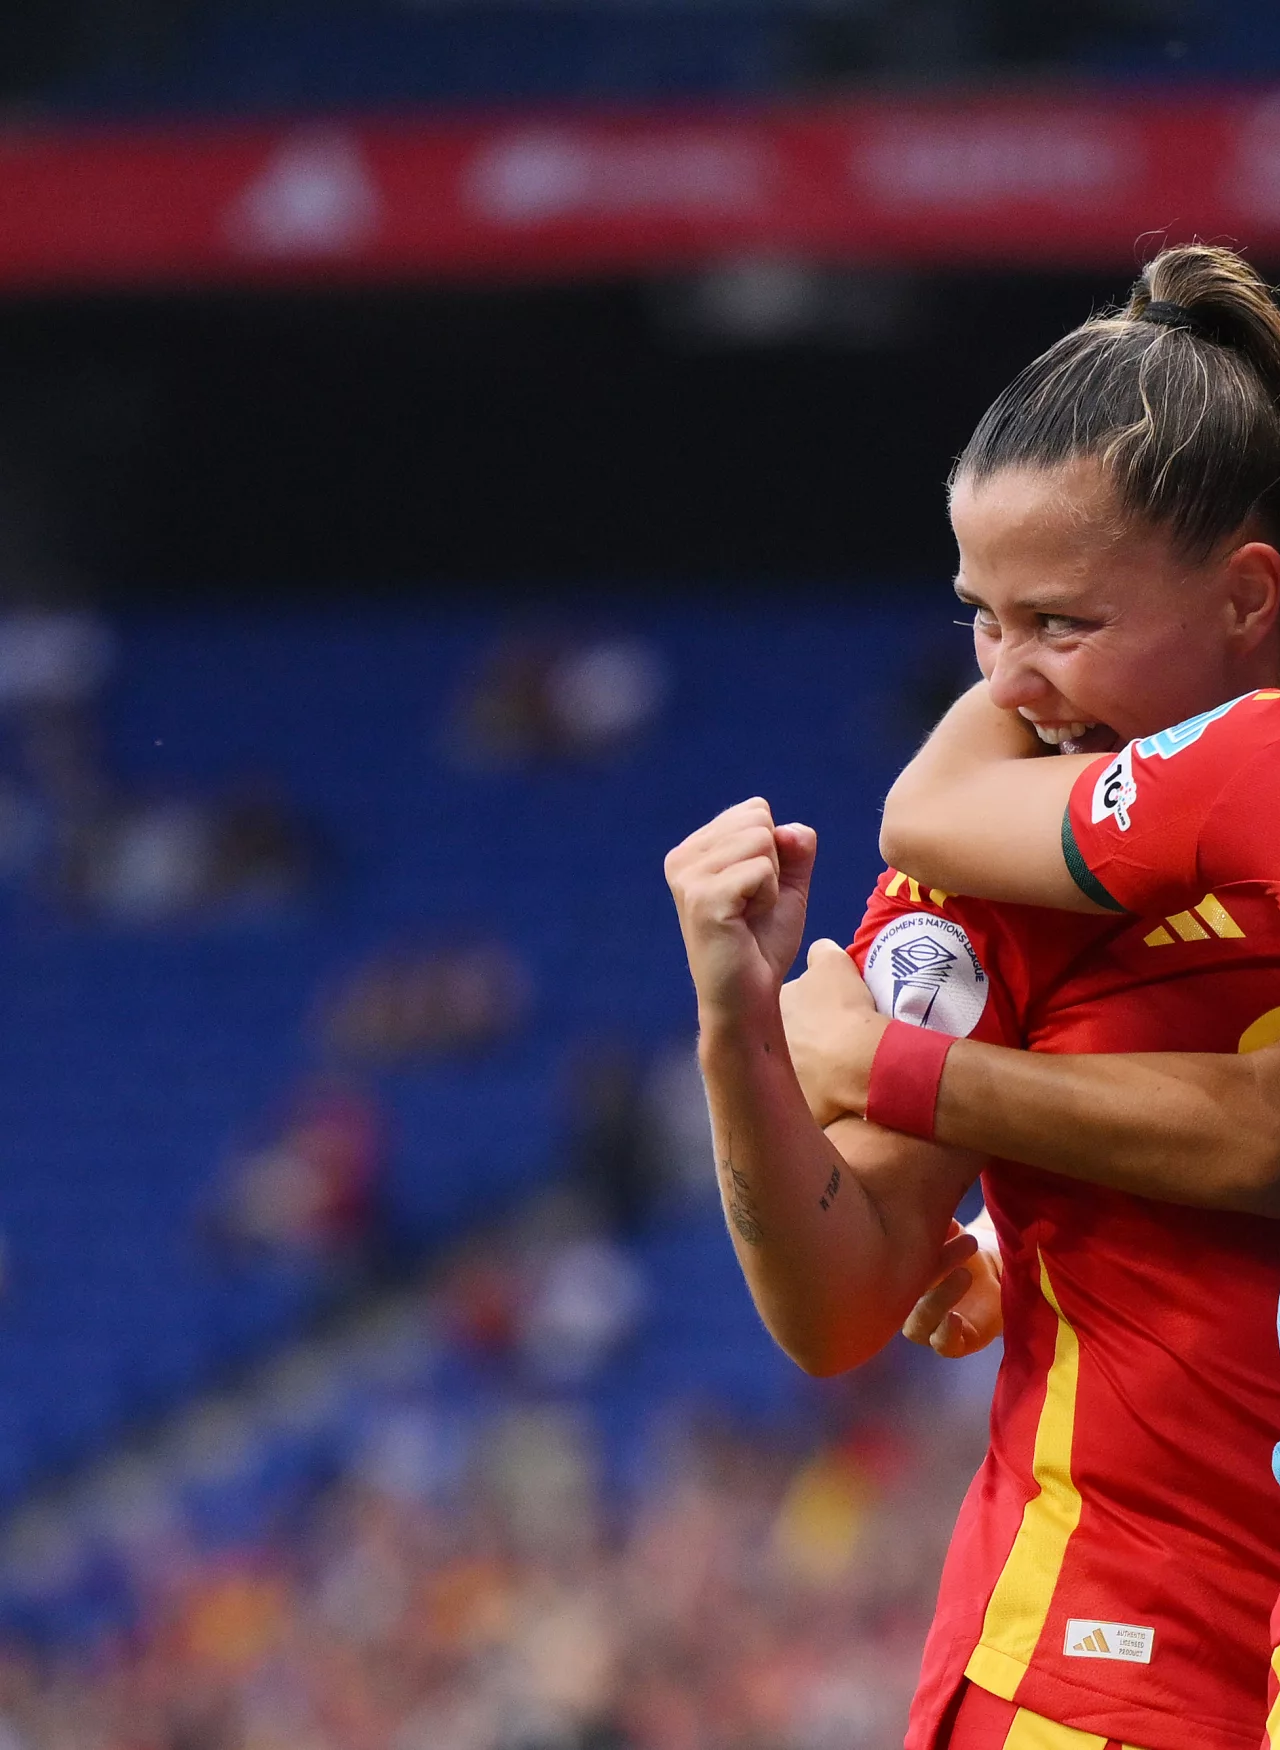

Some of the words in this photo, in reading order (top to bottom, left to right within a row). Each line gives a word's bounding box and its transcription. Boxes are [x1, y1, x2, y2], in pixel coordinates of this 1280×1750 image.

[868, 945, 882, 968] UEFA
[881, 918, 923, 943] WOMEN'S
[925, 918, 967, 943] NATIONS
[964, 940, 984, 982] LEAGUE
[1118, 1648, 1142, 1656] PRODUCT
